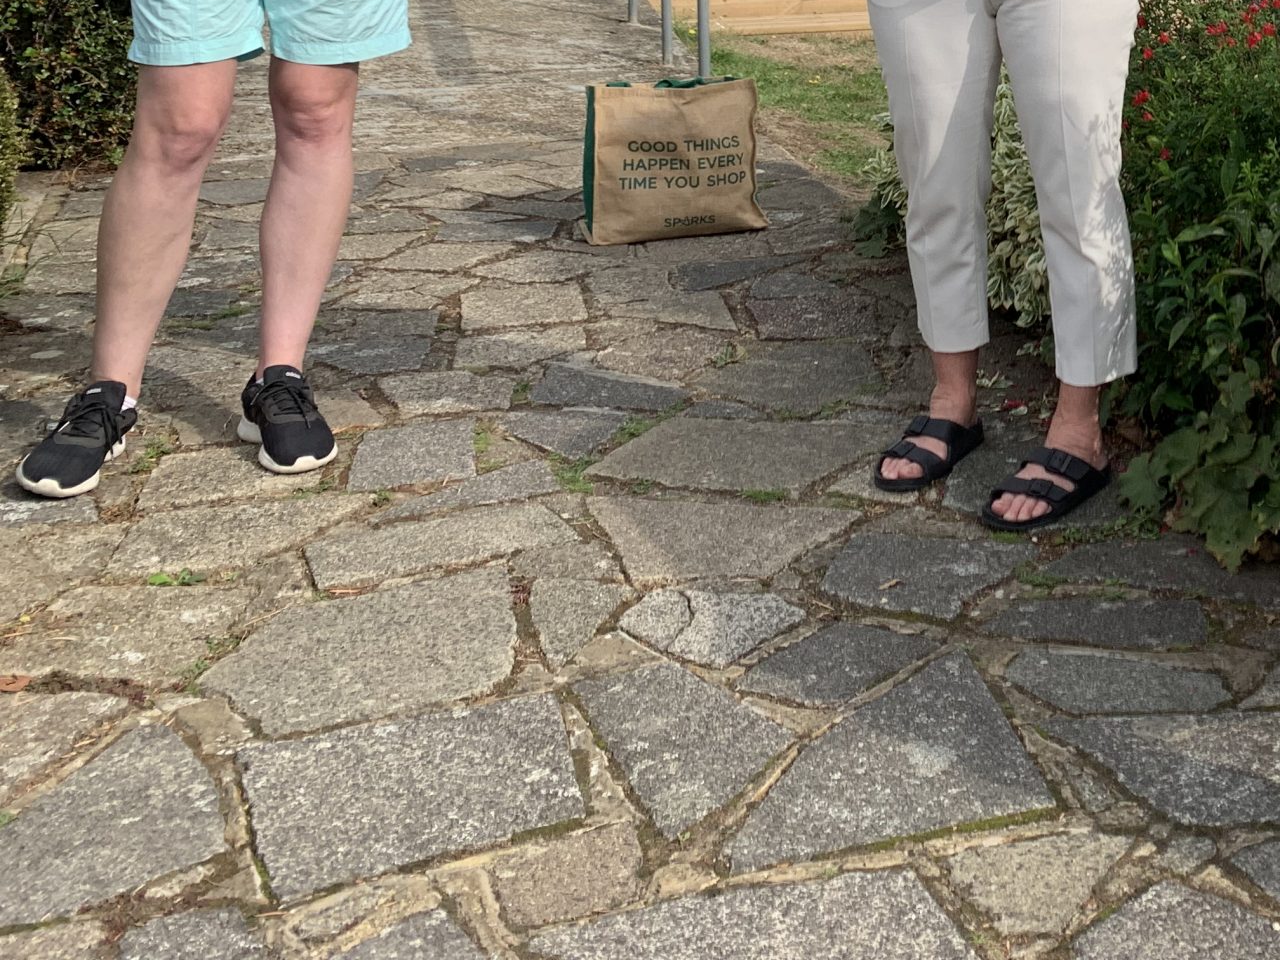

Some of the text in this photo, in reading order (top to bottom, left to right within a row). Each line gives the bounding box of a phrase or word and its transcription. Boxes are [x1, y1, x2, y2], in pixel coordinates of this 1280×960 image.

[627, 135, 740, 153] GOOD THINGS
[623, 153, 744, 171] HAPPEN EVERY
[619, 170, 747, 190] TIME YOU SHOP
[664, 214, 716, 228] SPARKS
